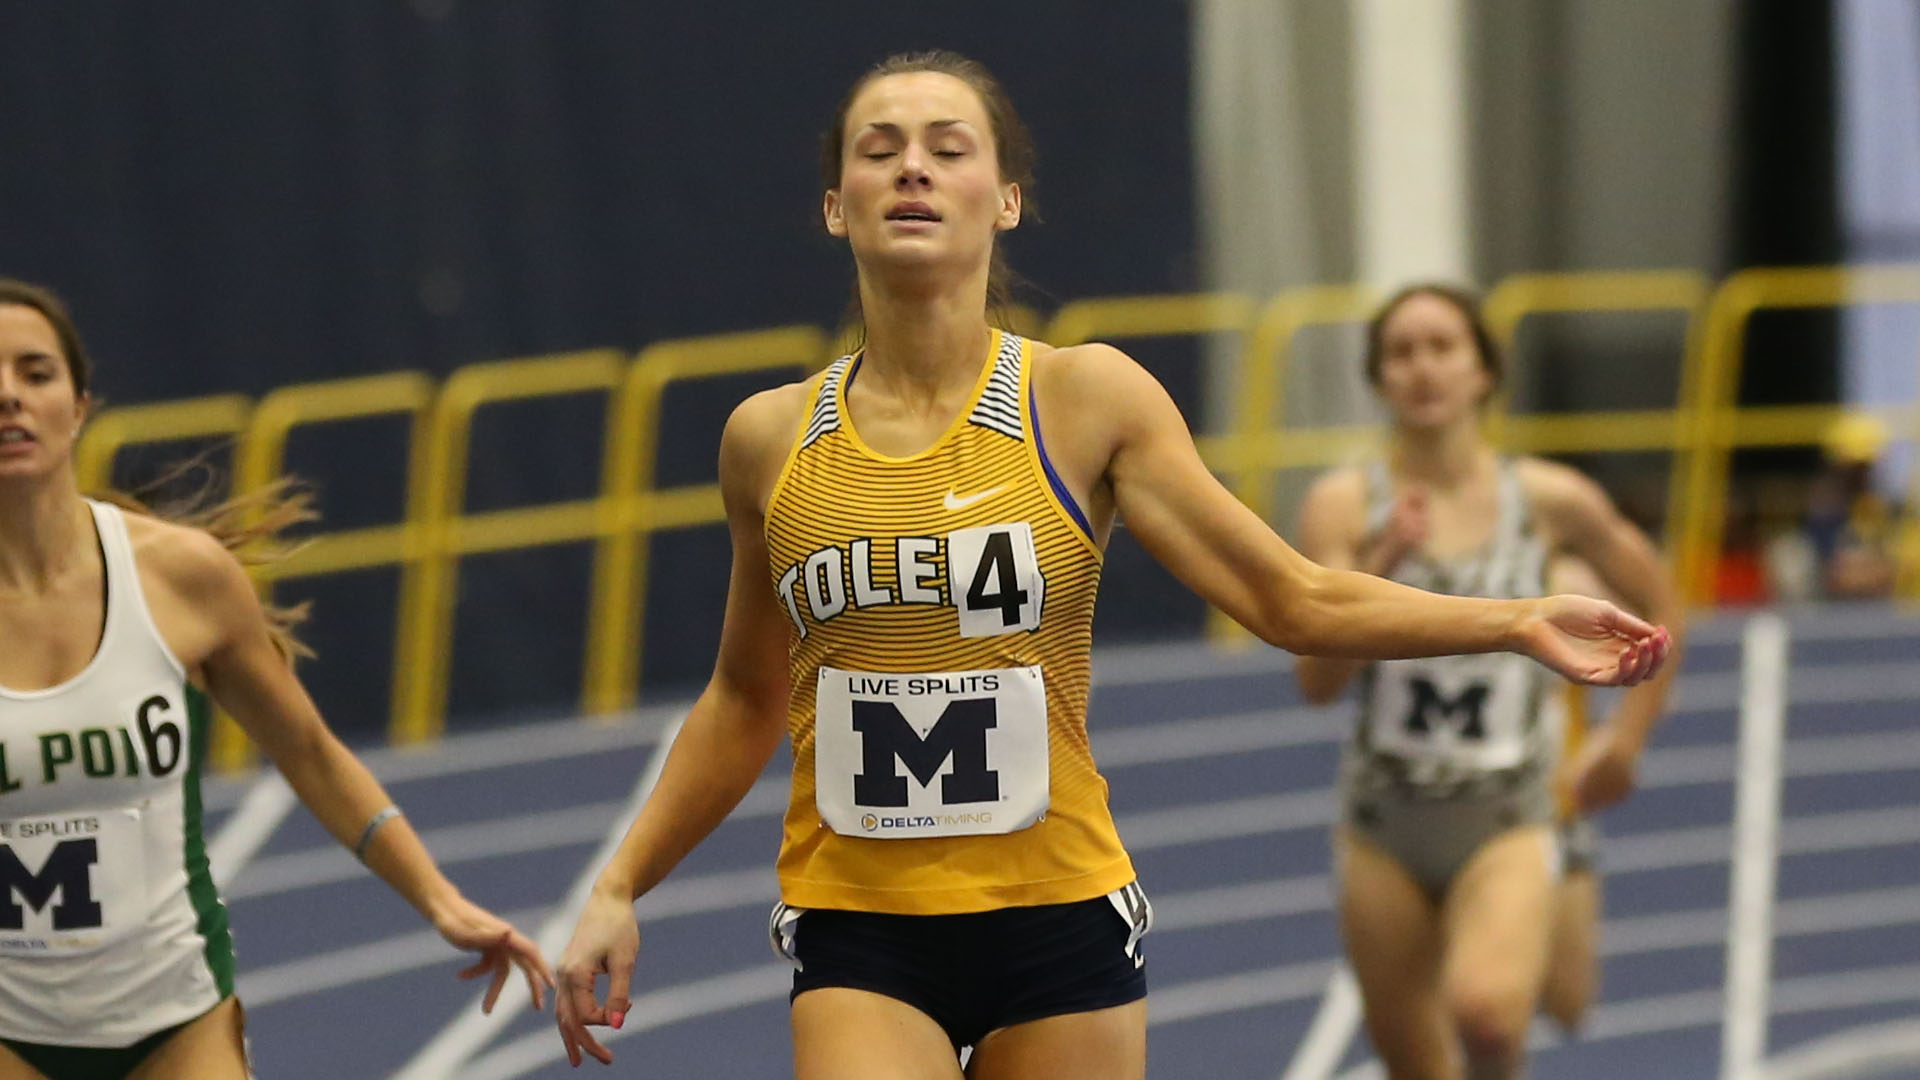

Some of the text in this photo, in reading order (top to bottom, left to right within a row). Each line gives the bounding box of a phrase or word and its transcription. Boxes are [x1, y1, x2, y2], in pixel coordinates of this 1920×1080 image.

[778, 536, 1047, 641] TOLE
[966, 531, 1029, 628] 4
[848, 675, 1000, 696] LIVE SPLITS
[1405, 677, 1491, 740] M
[137, 694, 182, 778] 6
[852, 697, 1000, 808] M
[19, 816, 100, 839] SPLITS
[0, 837, 103, 931] M
